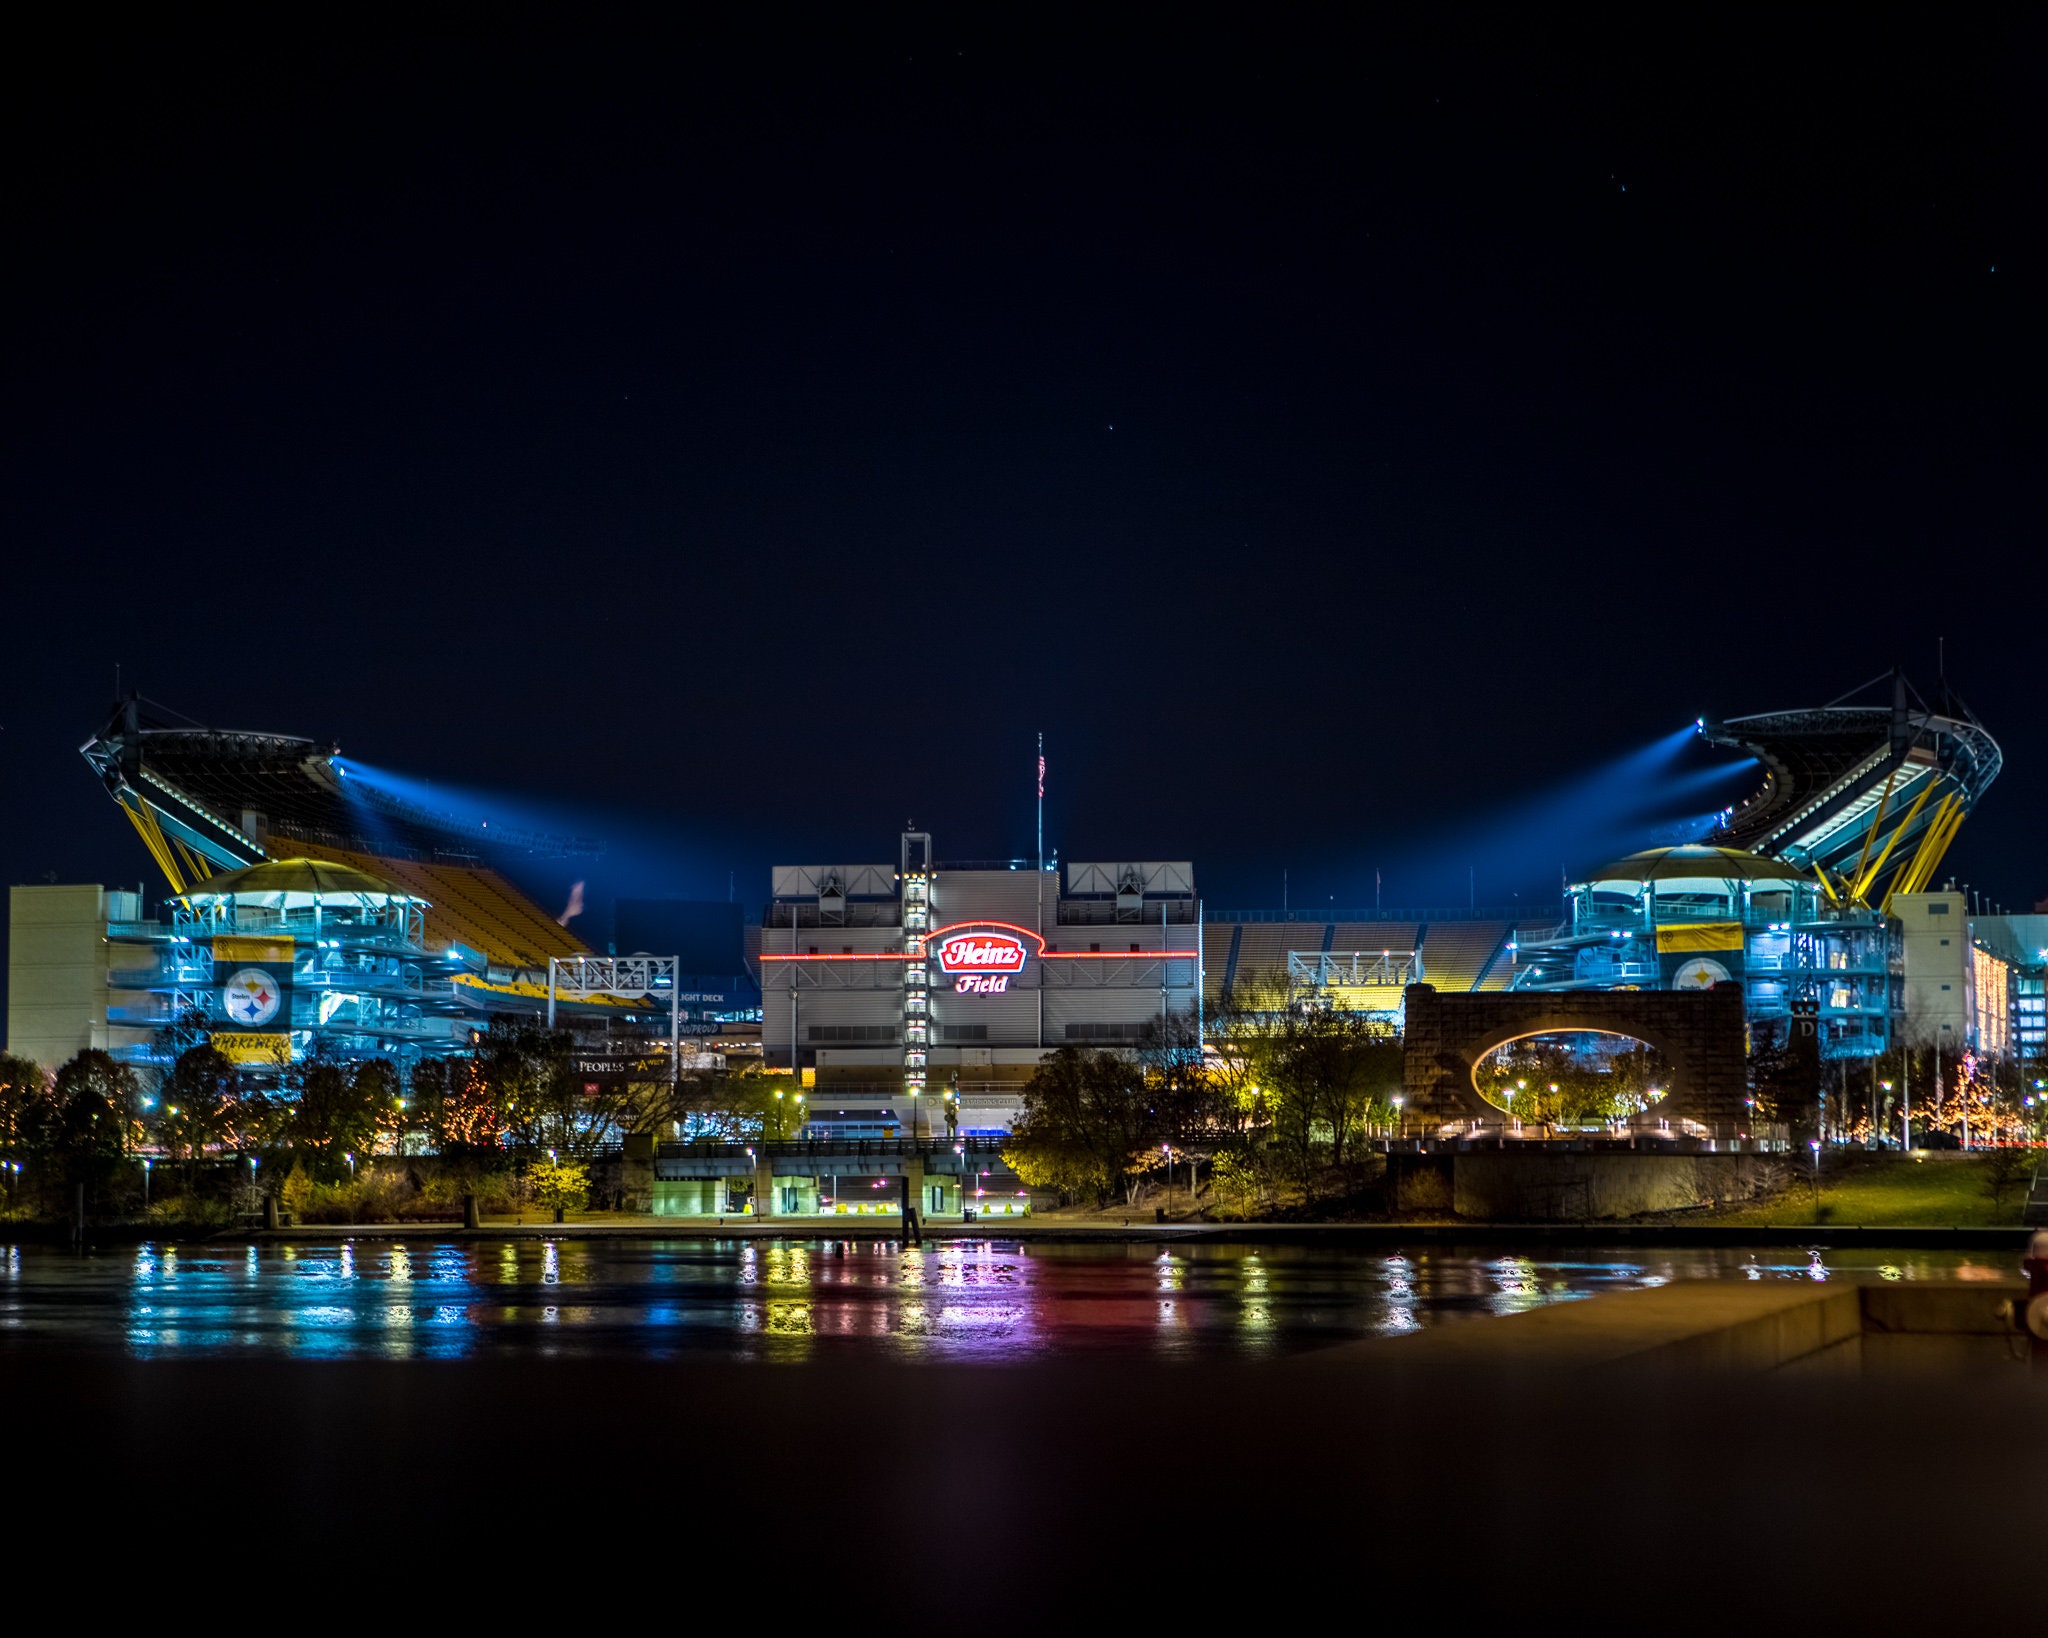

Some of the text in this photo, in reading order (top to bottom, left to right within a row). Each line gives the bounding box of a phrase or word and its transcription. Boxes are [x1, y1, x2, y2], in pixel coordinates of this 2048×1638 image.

[945, 941, 1019, 965] Heinz
[955, 974, 1009, 993] Field
[679, 993, 701, 1002] IGHT
[702, 993, 724, 1002] DECK
[1800, 1021, 1815, 1037] D
